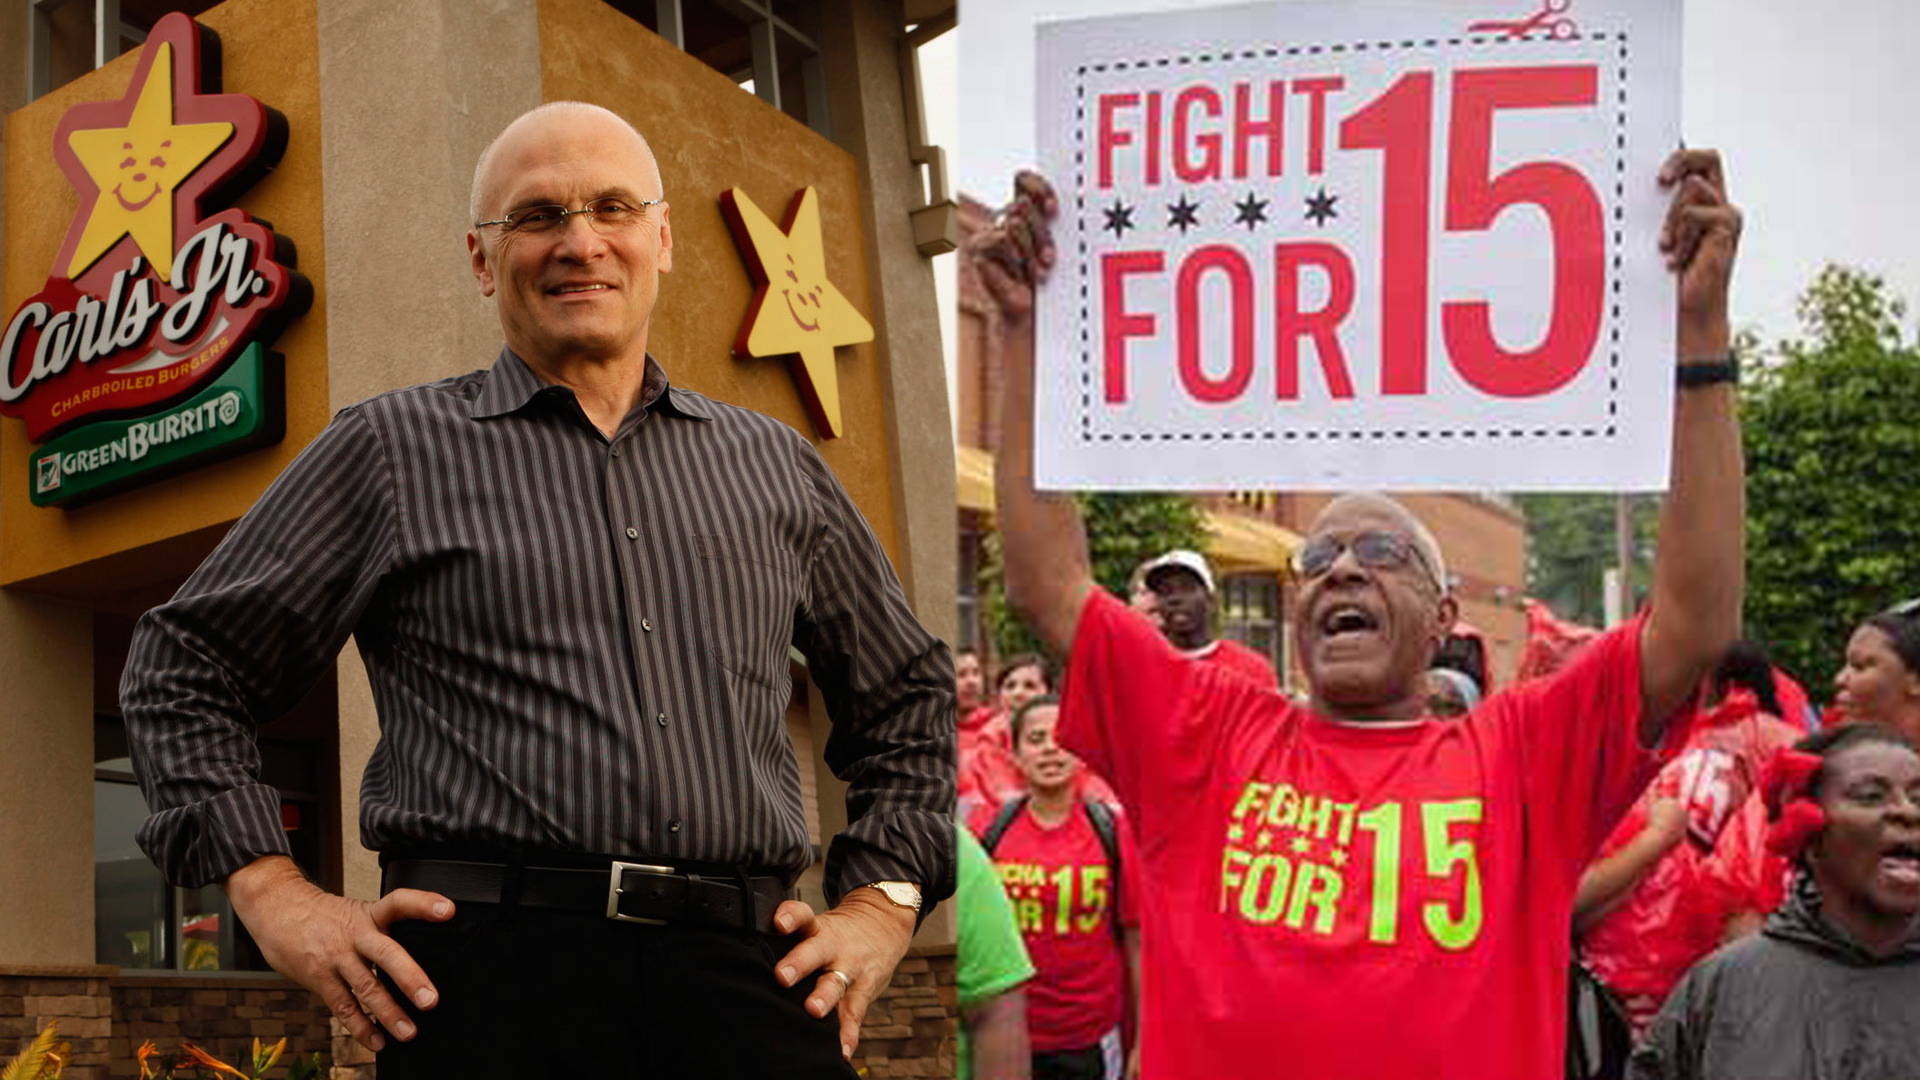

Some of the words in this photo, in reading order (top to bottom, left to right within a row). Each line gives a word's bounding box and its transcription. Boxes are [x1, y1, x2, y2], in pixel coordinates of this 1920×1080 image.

[1098, 76, 1345, 190] FIGHT
[1100, 240, 1356, 404] FOR
[1338, 64, 1606, 399] 15
[0, 256, 159, 401] Carl's
[161, 222, 265, 341] Jr.
[51, 374, 155, 418] CHARBROILED
[158, 336, 230, 385] BURGERS
[1051, 864, 1108, 934] 15
[1219, 845, 1344, 934] FOR
[1357, 797, 1484, 950] 15
